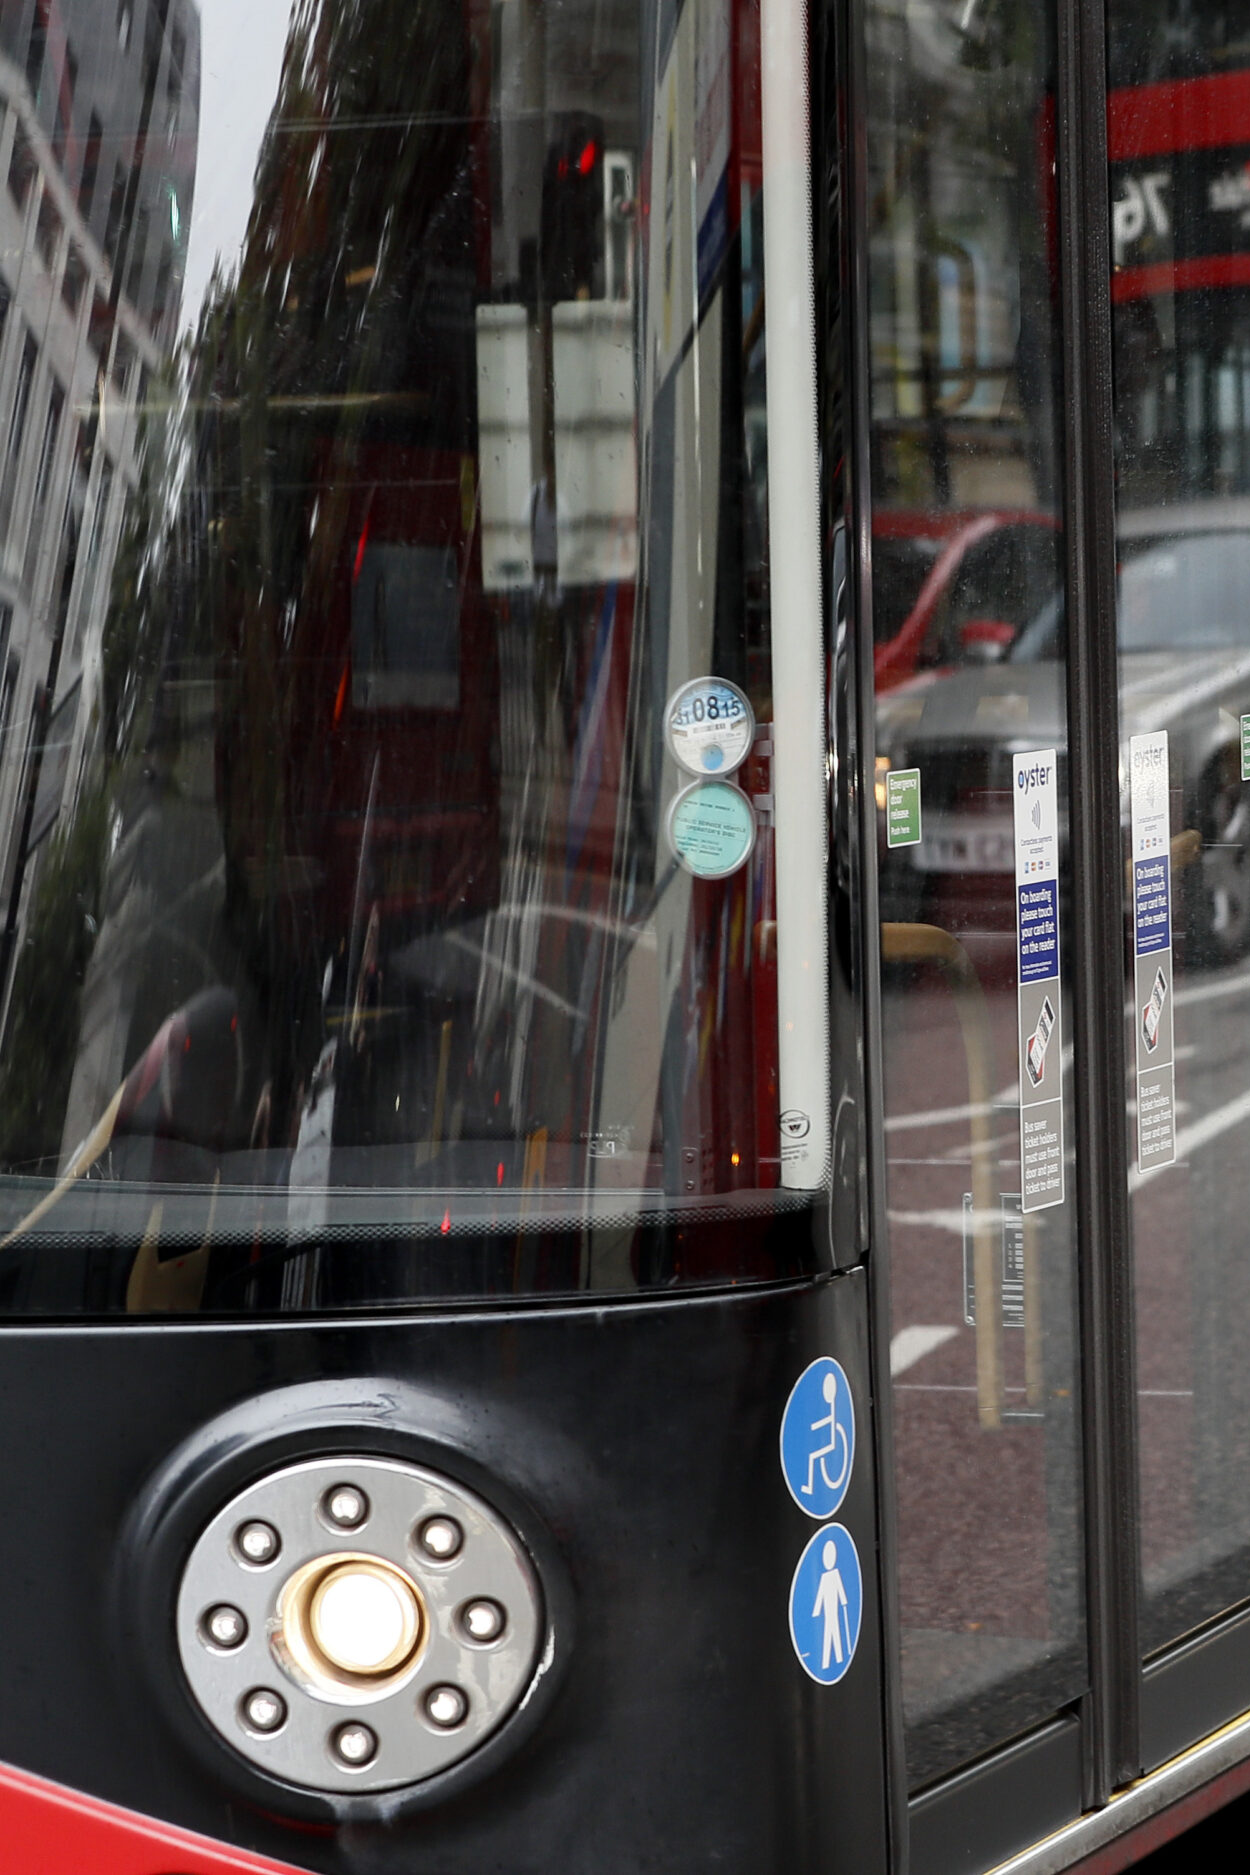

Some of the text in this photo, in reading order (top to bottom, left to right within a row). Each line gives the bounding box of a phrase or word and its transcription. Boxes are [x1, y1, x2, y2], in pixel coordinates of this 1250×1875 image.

[692, 695, 720, 723] 08
[722, 700, 741, 718] 15
[1134, 744, 1164, 775] oyster
[890, 778, 917, 791] Emergency
[1018, 763, 1050, 795] oyster
[890, 793, 903, 806] door
[890, 808, 910, 820] release
[891, 825, 910, 836] Push here
[1137, 864, 1164, 880] On boarding
[1020, 888, 1052, 905] On boarding
[1137, 879, 1165, 899] please touch
[1137, 895, 1167, 915] your card flat
[1021, 904, 1054, 925] please touch
[1138, 910, 1168, 928] on the reader
[1021, 921, 1055, 941] your card flat
[1022, 938, 1056, 955] on the reader
[1149, 1084, 1160, 1095] saver
[1141, 1096, 1170, 1112] ticket holders
[1024, 1120, 1048, 1134] Bus saver
[1142, 1110, 1172, 1127] must use front
[1025, 1132, 1057, 1149] ticket holders
[1142, 1125, 1171, 1141] door and pass
[1025, 1146, 1060, 1165] must use front
[1142, 1144, 1154, 1156] ticket
[1160, 1138, 1172, 1151] driver
[1025, 1163, 1058, 1180] door and pass
[1026, 1182, 1040, 1195] ticket
[1046, 1177, 1060, 1190] driver
